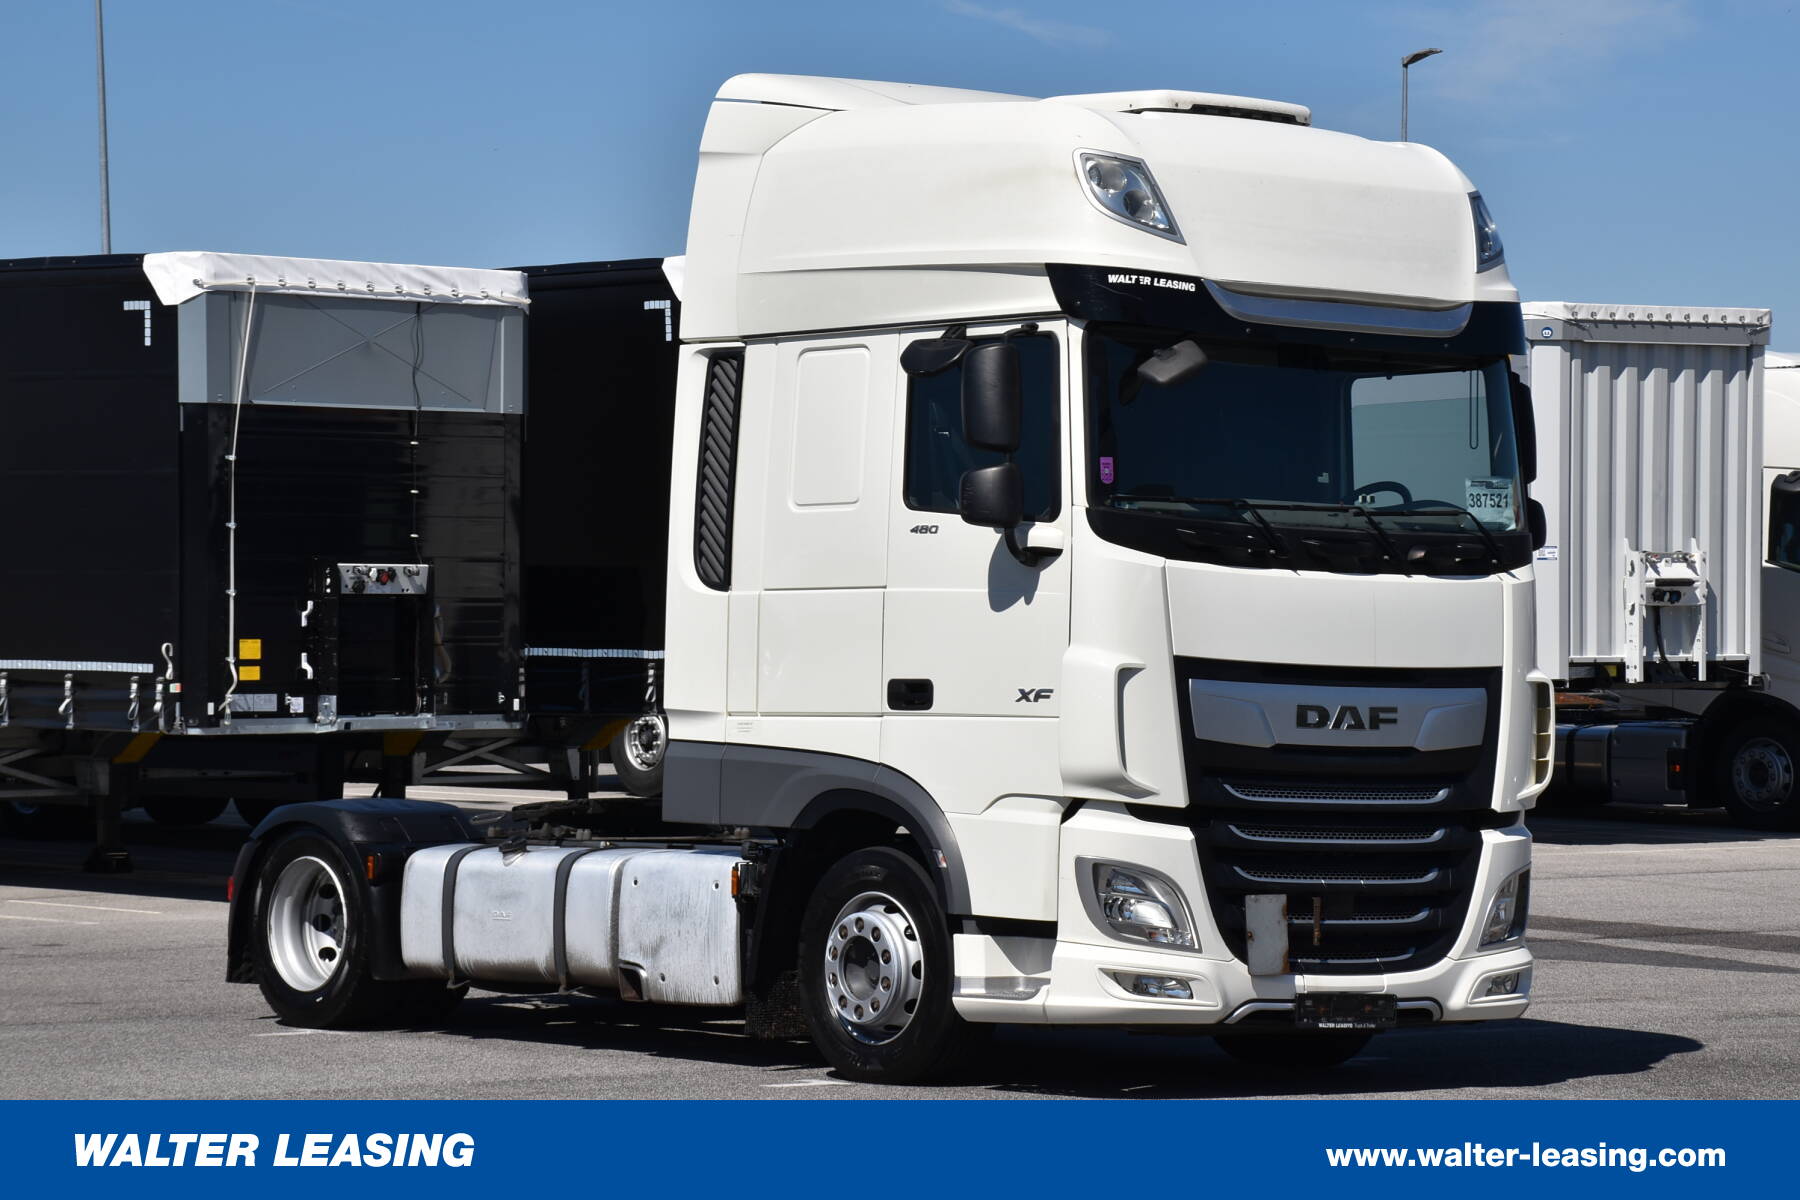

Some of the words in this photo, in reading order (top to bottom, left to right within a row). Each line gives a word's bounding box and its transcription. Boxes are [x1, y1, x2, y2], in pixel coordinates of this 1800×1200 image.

[1107, 274, 1151, 286] WALTER
[1153, 277, 1196, 292] LEASING
[1469, 493, 1508, 508] 387521
[910, 524, 939, 534] 480
[1015, 688, 1054, 703] XF
[1296, 704, 1398, 730] DAF
